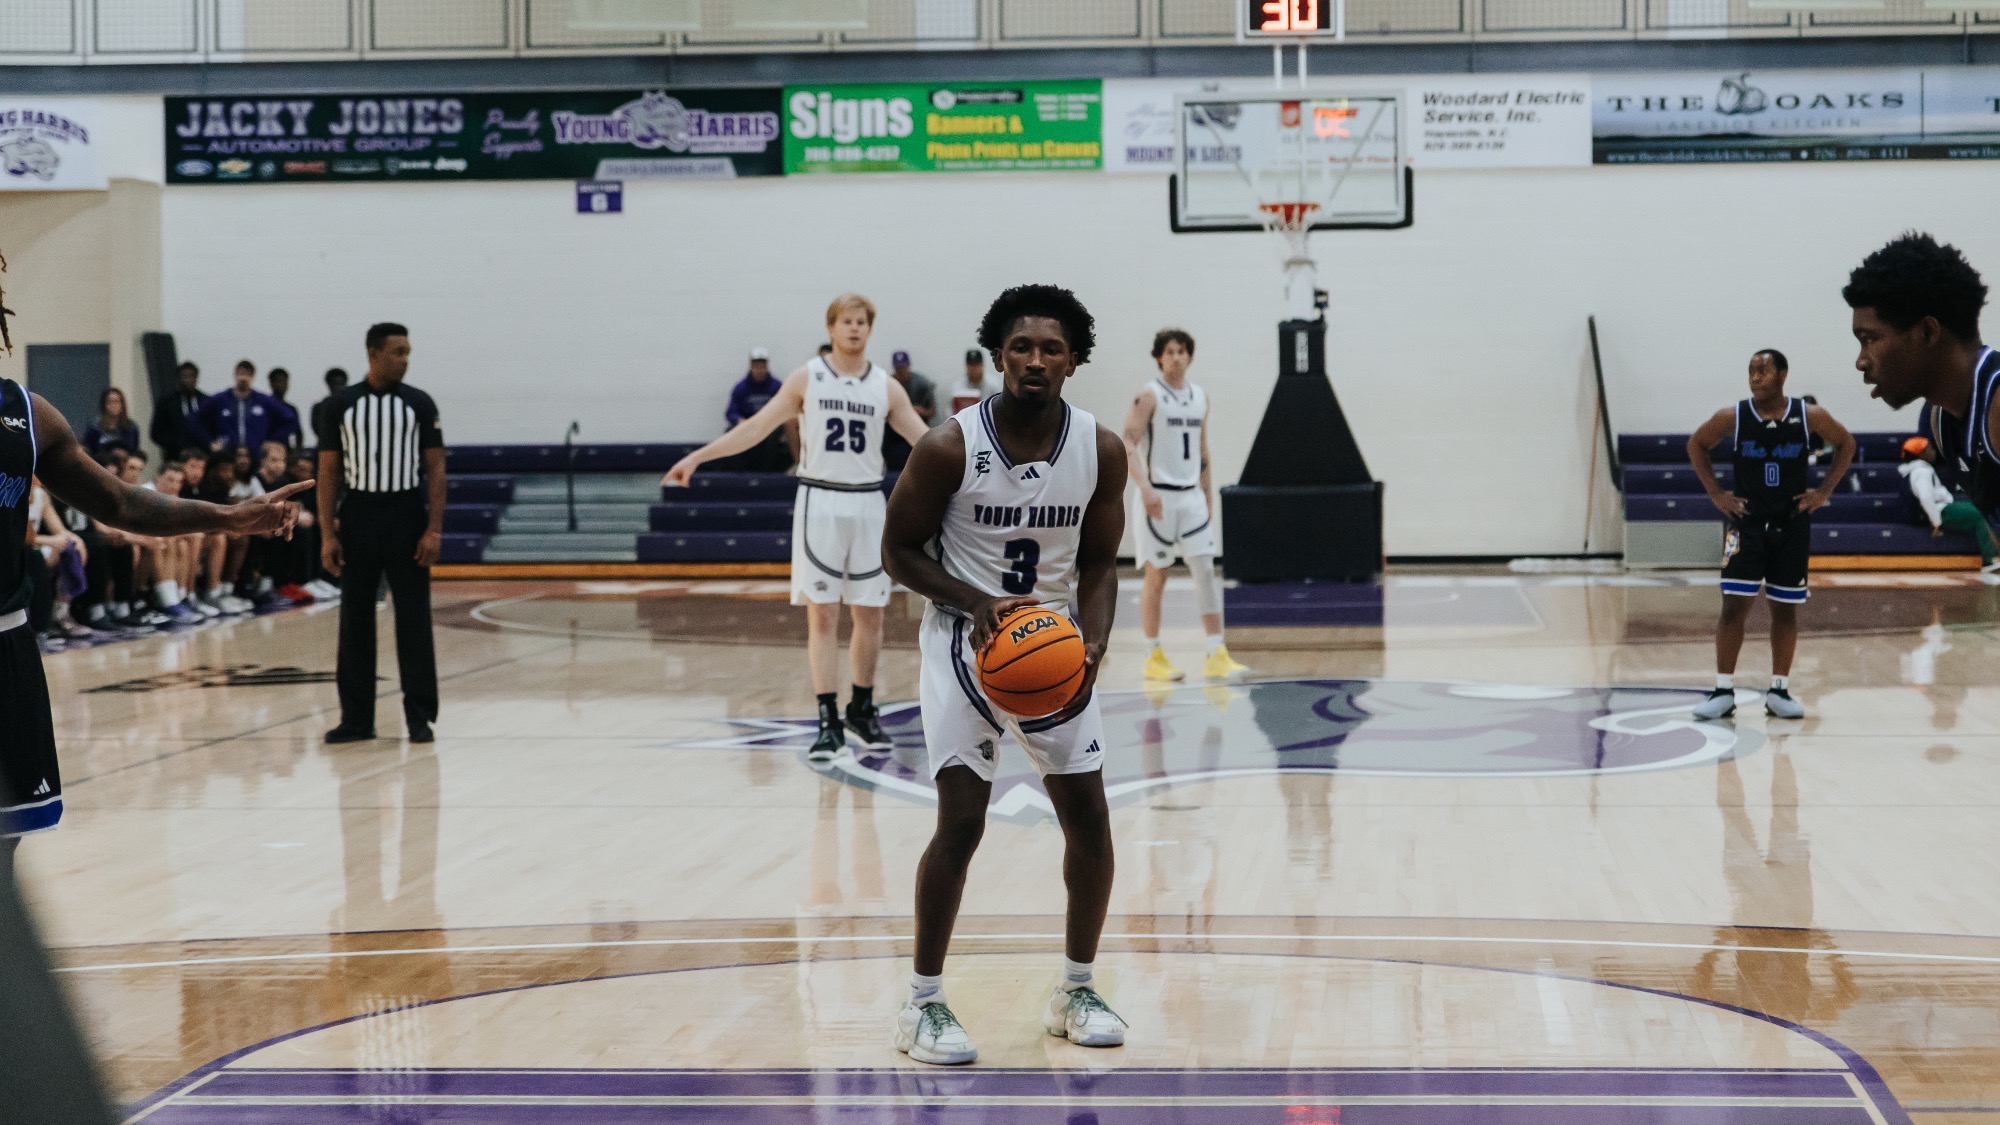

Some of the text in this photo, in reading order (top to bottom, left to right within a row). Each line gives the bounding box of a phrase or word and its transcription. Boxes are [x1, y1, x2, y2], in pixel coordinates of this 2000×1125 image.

[1261, 0, 1318, 32] 30
[1423, 89, 1586, 106] Woodard Electric
[1607, 92, 1905, 112] THE OAKS
[176, 98, 465, 137] JACKY JONES
[789, 90, 914, 144] Signs
[207, 137, 431, 153] AUTOMOTIVE GROUP
[1125, 146, 1197, 163] MOUNTN
[4, 416, 27, 429] SAC
[825, 417, 866, 455] 25
[1183, 432, 1190, 460] 1
[1765, 462, 1780, 487] 0
[974, 504, 1081, 528] YOUNG HARRIS
[1001, 537, 1040, 596] 3
[1010, 616, 1058, 644] NCAA
